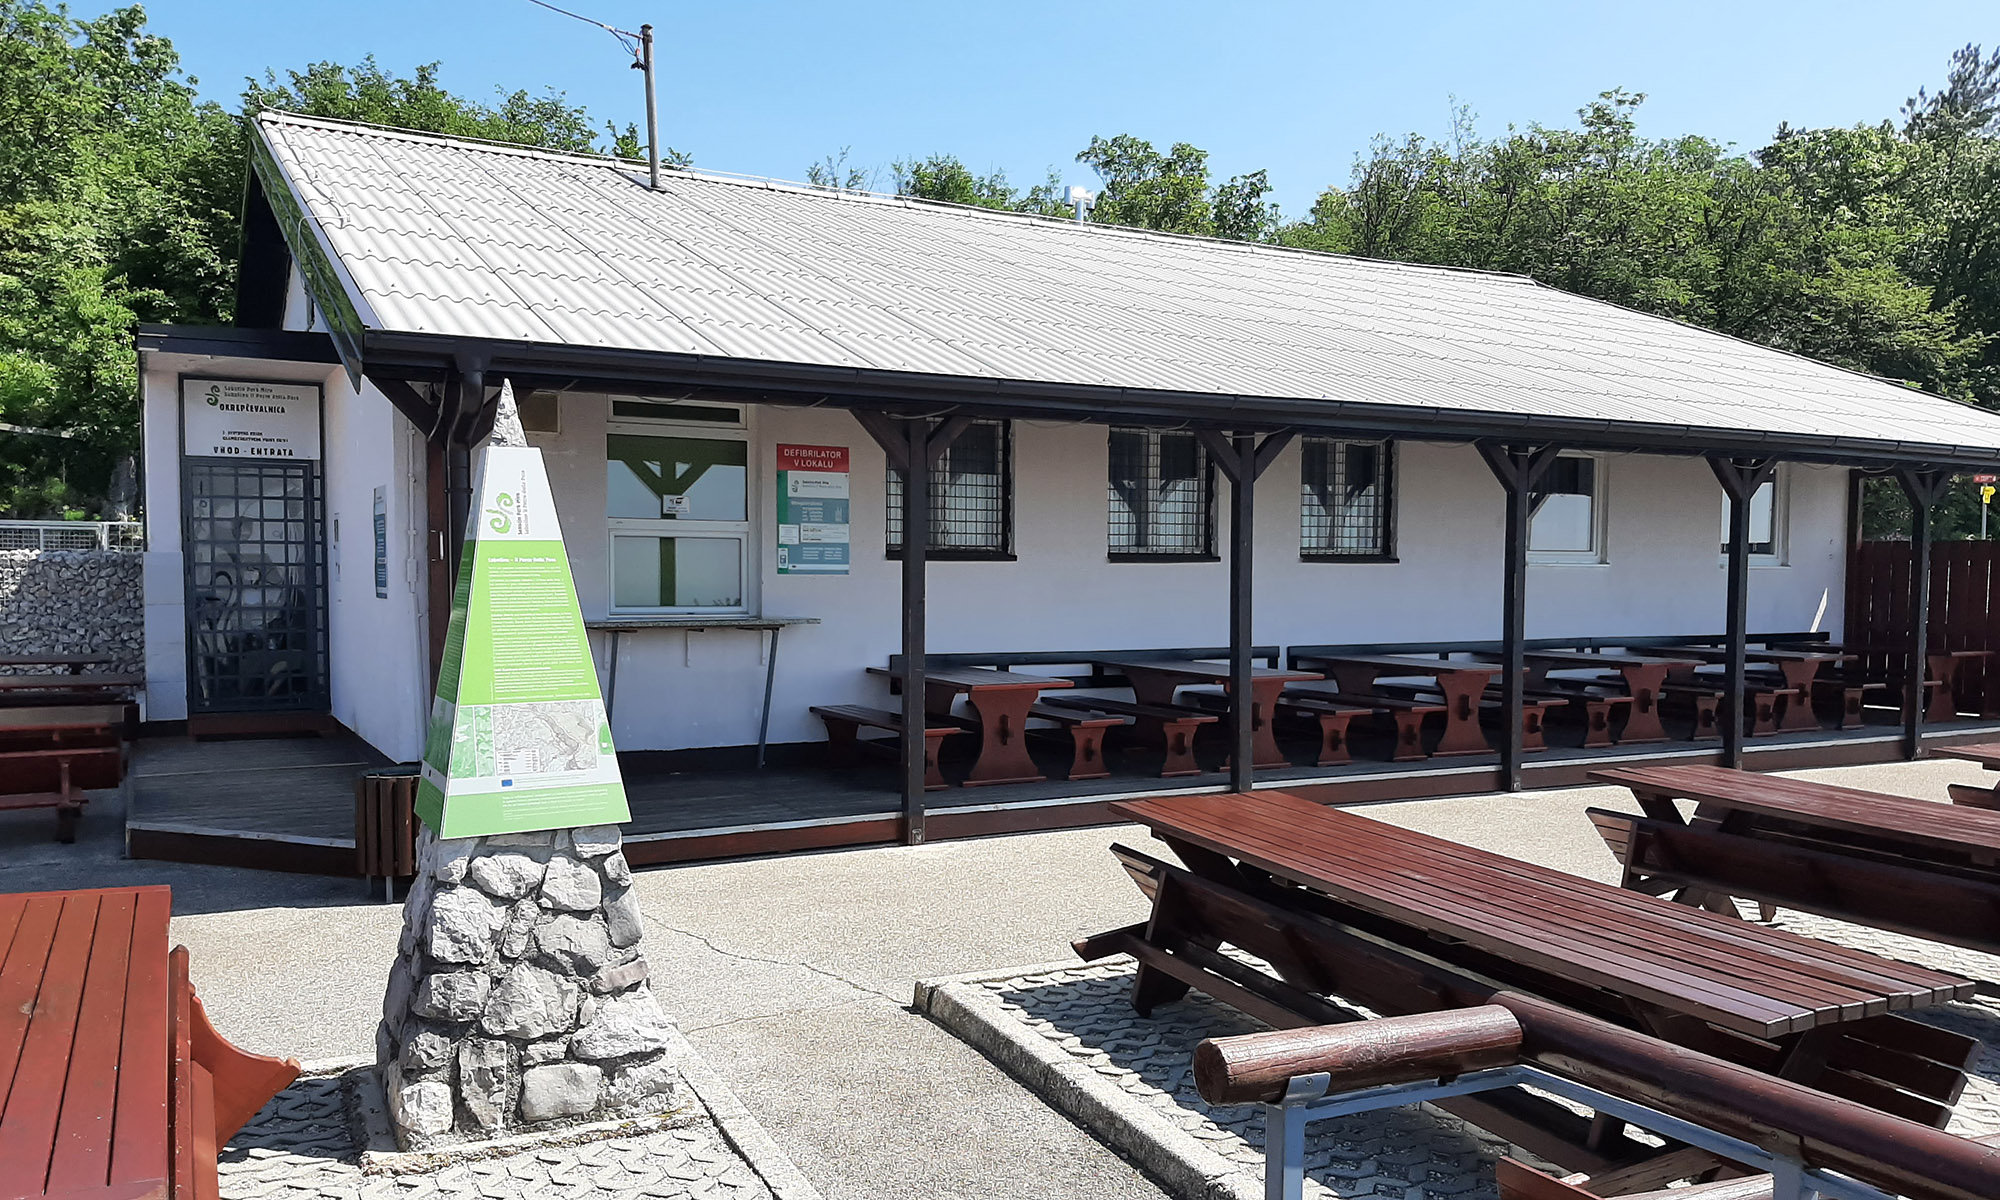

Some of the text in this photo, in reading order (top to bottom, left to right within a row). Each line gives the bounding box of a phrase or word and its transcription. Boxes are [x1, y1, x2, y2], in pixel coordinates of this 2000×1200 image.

[219, 403, 286, 414] OKREPČEVALNICA
[213, 446, 240, 455] VHOD
[250, 447, 294, 457] ENTRATA
[784, 448, 842, 459] DEFIBRILATOR
[794, 459, 834, 468] V LOKALU
